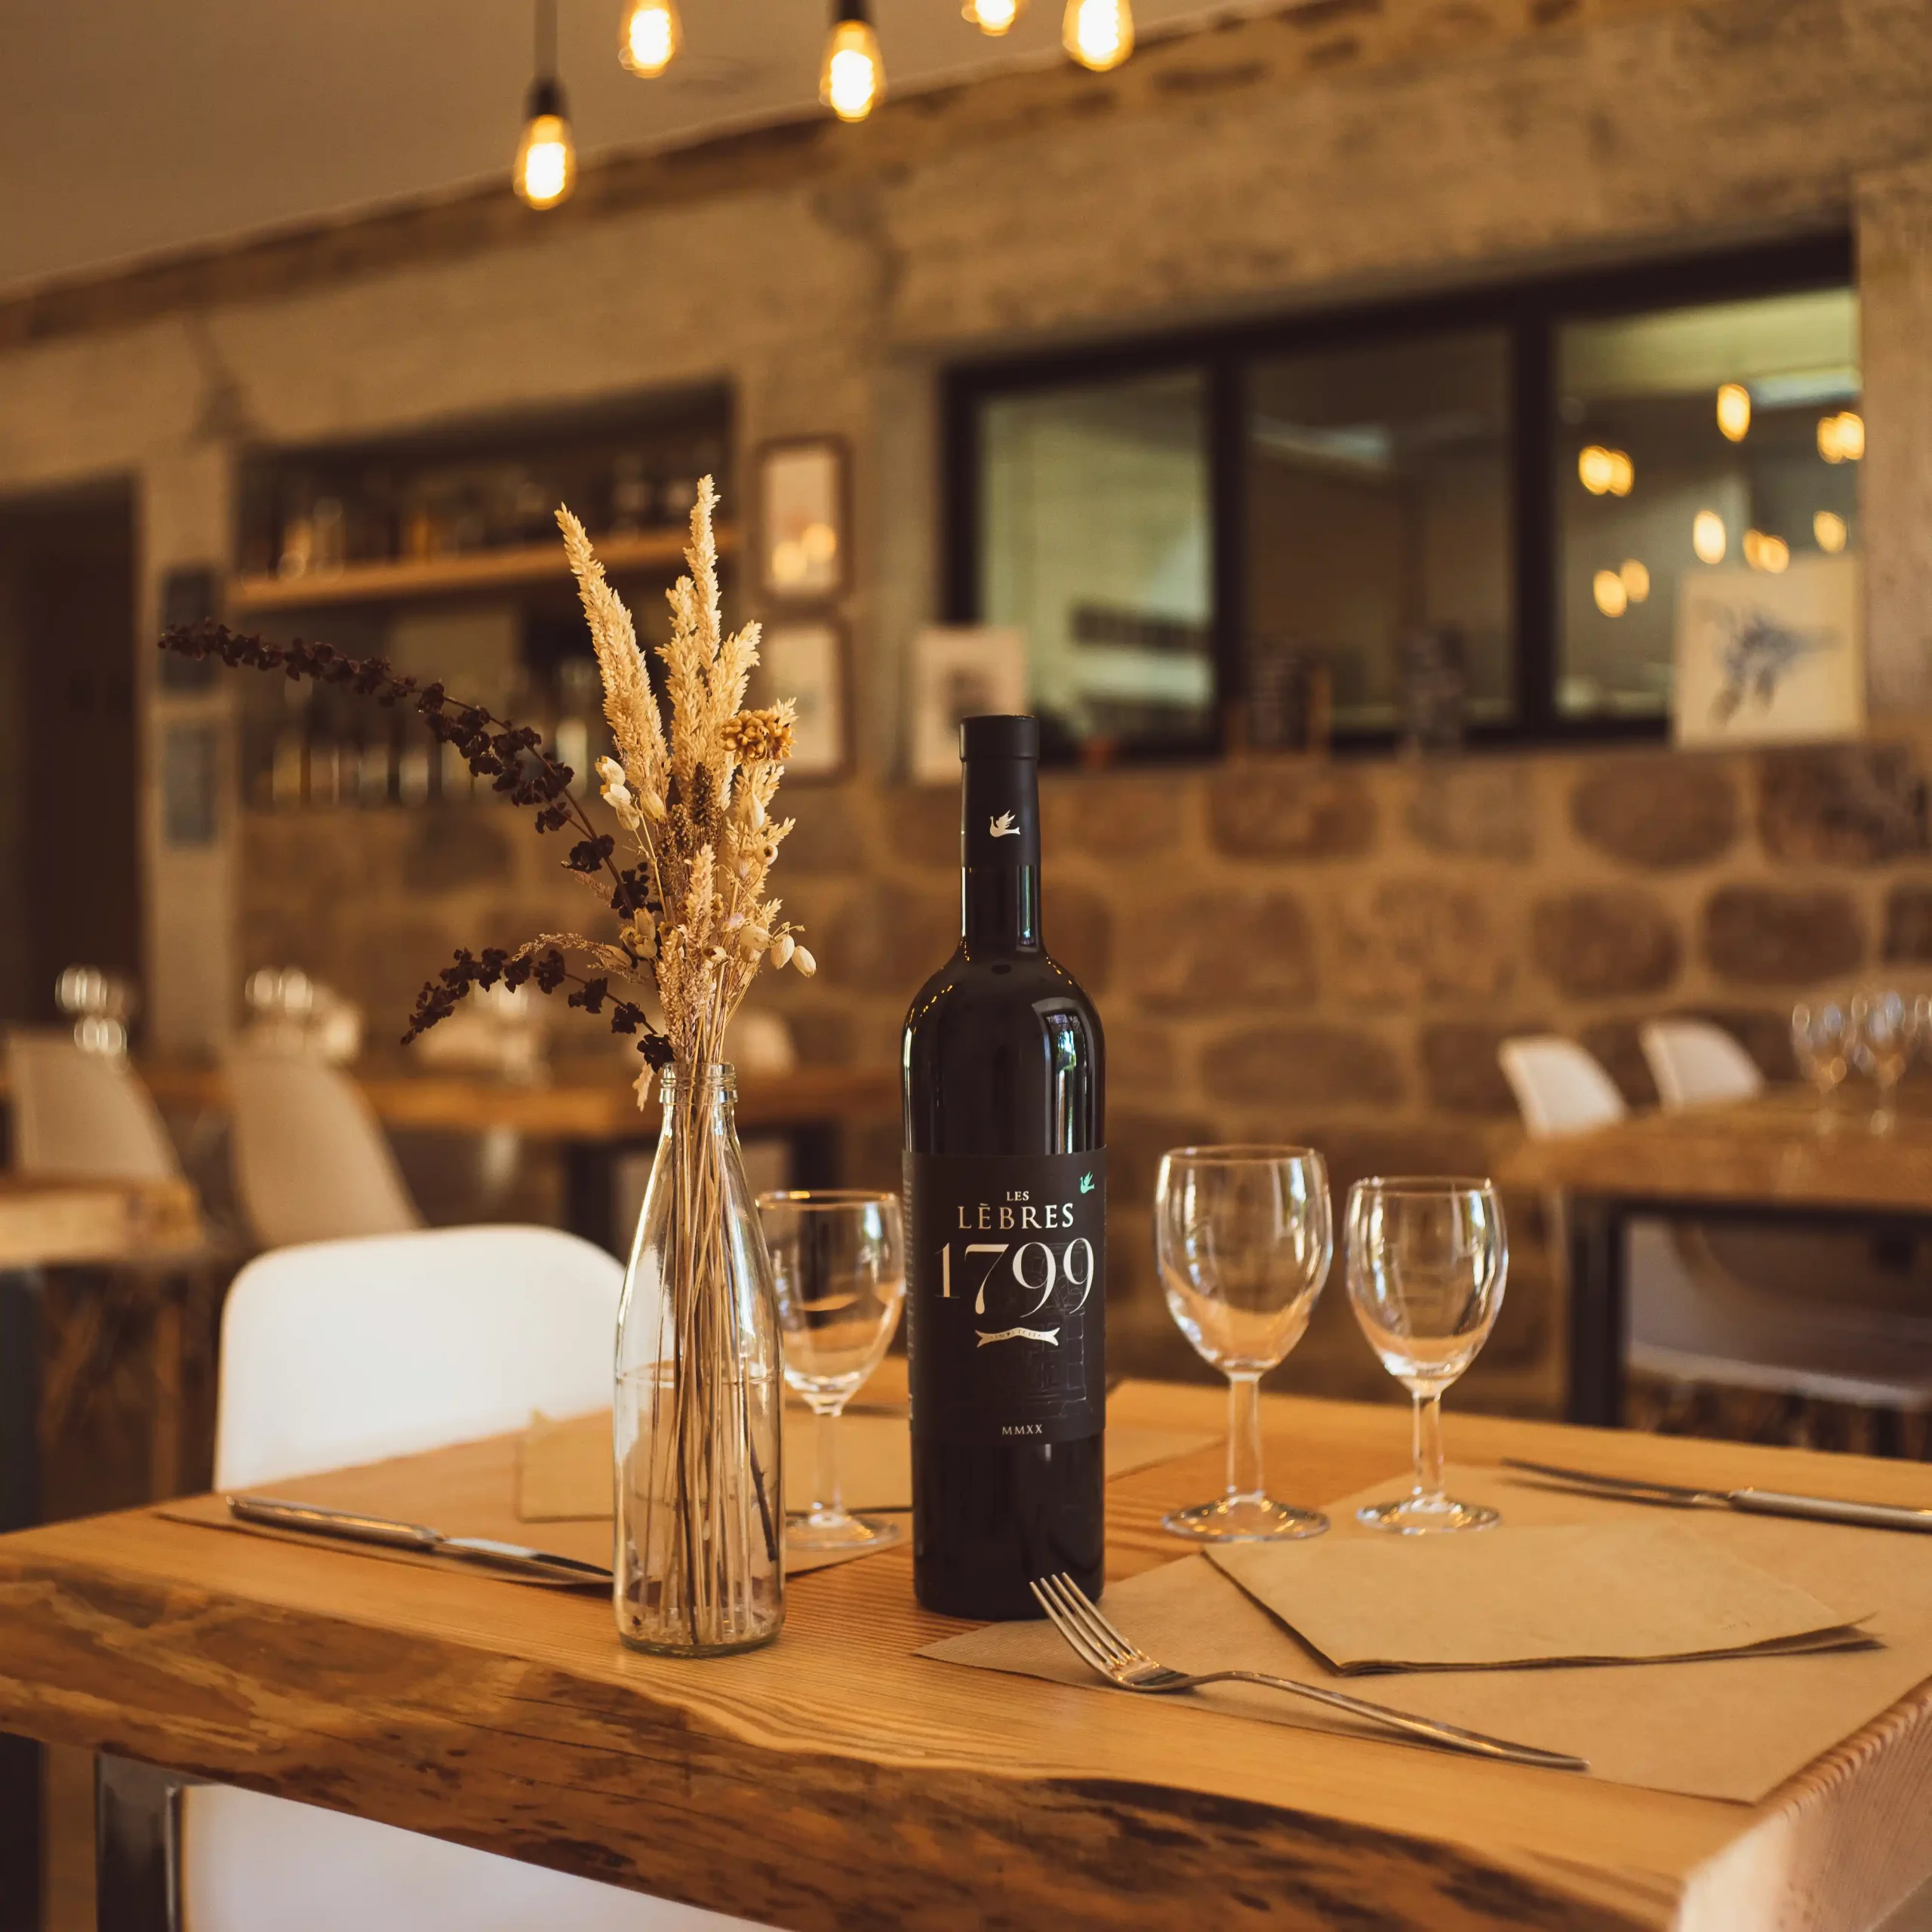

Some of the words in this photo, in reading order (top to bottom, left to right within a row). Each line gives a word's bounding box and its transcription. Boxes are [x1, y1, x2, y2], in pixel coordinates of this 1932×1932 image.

[1006, 1190, 1029, 1201] LES
[958, 1202, 1074, 1229] LÈBRES
[934, 1238, 1094, 1318] 1799
[1001, 1424, 1042, 1435] MMXX
